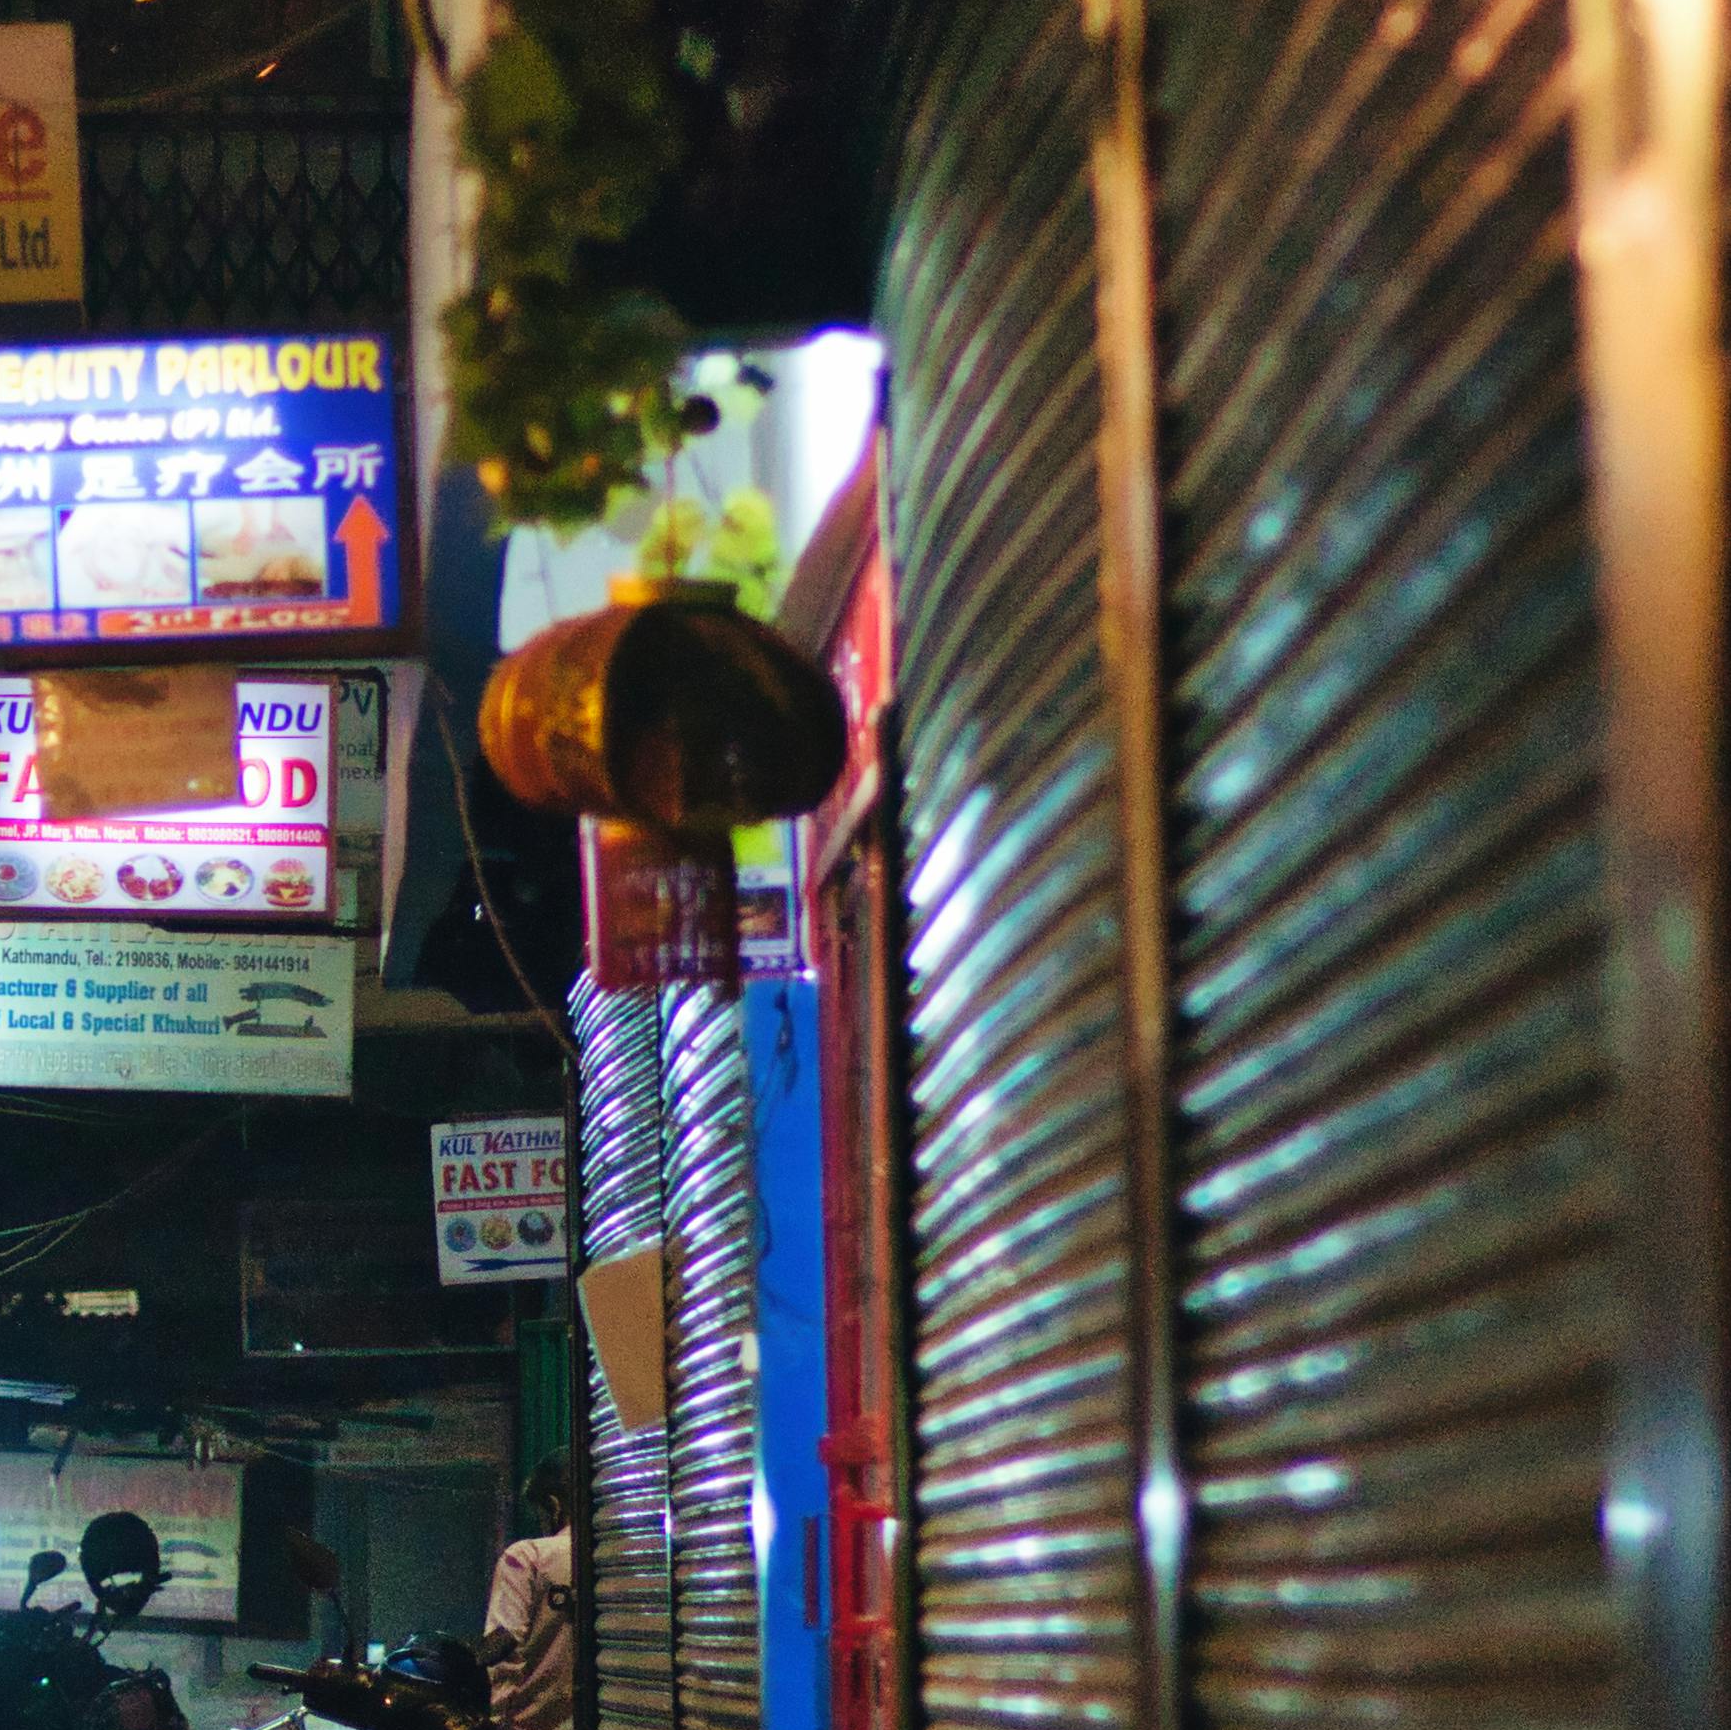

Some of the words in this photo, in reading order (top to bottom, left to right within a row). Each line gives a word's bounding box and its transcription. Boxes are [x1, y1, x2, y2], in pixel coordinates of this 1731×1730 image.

[155, 340, 383, 399] PARLOUR
[238, 701, 323, 734] NDU
[241, 755, 319, 809] OD
[41, 825, 73, 842] Marg,
[144, 826, 185, 842] Mobile:
[2, 948, 81, 969] Kathmandu,
[65, 977, 78, 1000] &
[84, 979, 156, 1005] Supplier
[163, 981, 183, 1003] of
[186, 982, 208, 1004] all
[7, 1009, 56, 1032] Local
[62, 1012, 75, 1032] &
[80, 1011, 147, 1037] Special
[151, 1013, 223, 1036] Khukuri
[439, 1135, 477, 1157] KUL
[482, 1129, 562, 1157] KATHM
[441, 1159, 518, 1194] FAST
[530, 1156, 567, 1188] FO
